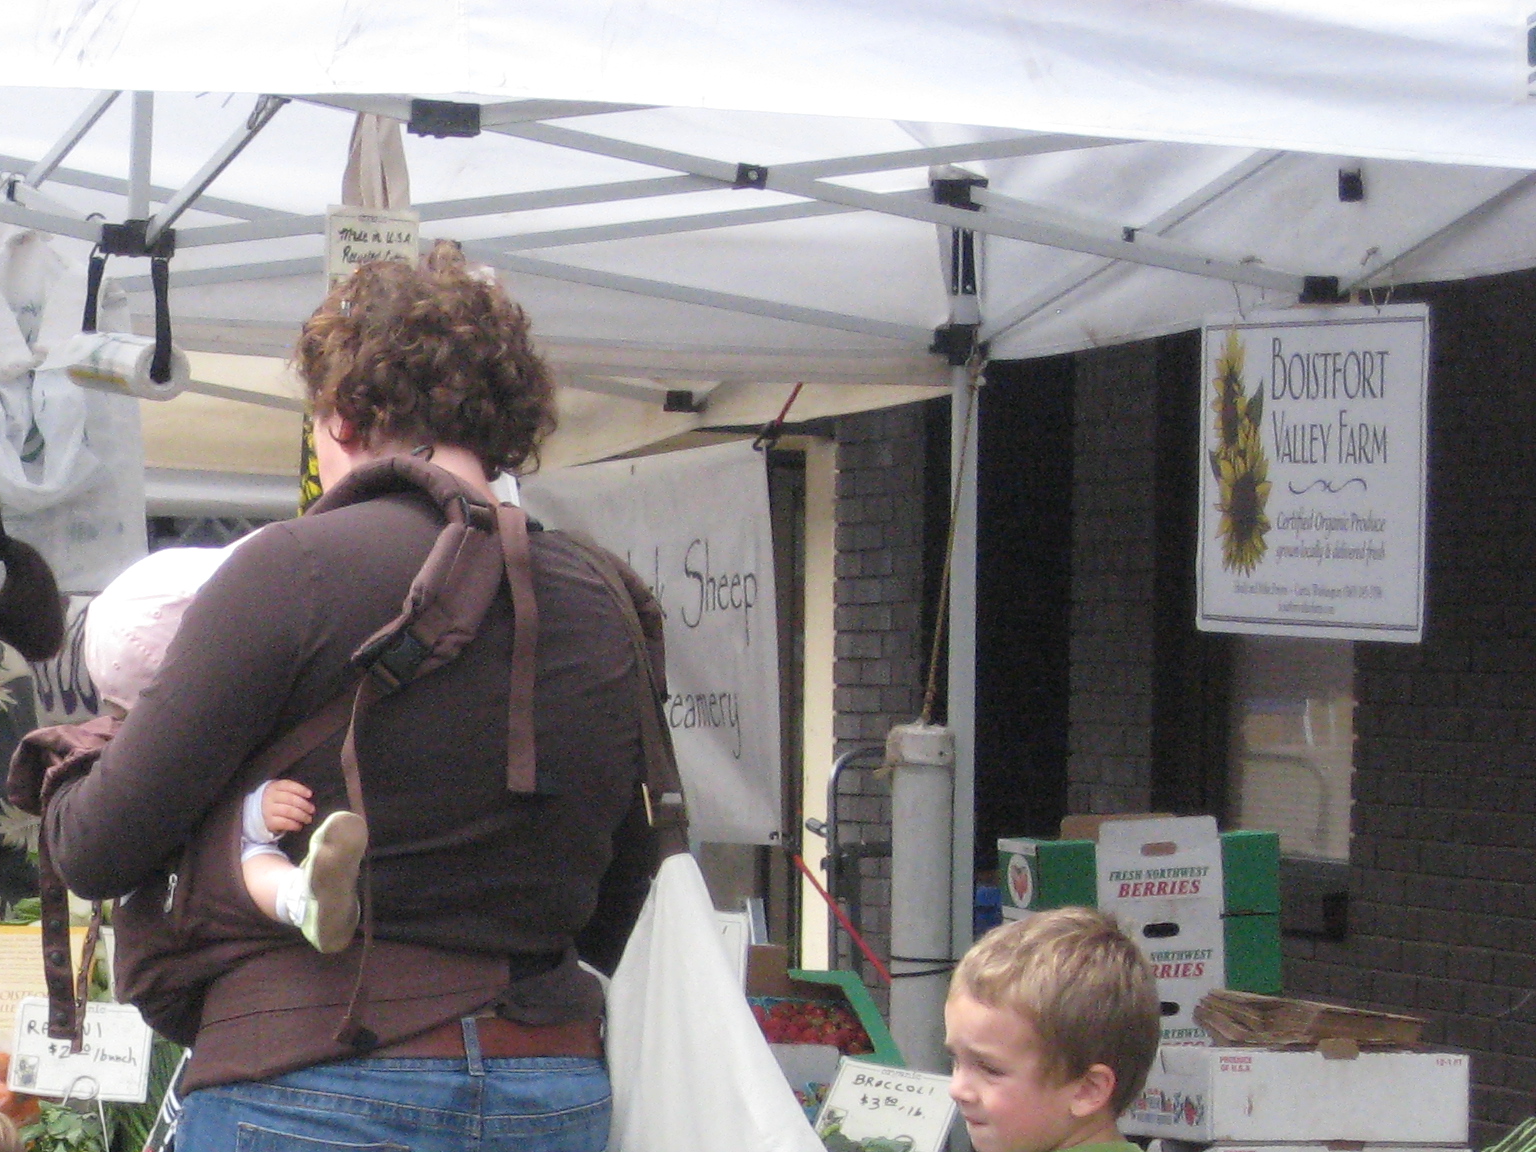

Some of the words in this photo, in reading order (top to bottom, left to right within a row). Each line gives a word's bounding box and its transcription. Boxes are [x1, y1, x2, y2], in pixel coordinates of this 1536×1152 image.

[1338, 409, 1388, 464] FARM
[681, 538, 759, 647] Sheep
[668, 692, 742, 760] eamery
[1109, 869, 1143, 881] FRESH
[1146, 866, 1210, 880] NORTHWEST
[1118, 879, 1201, 898] BERRIES
[1151, 962, 1205, 979] RRIES
[853, 1073, 935, 1096] BROCCOLI
